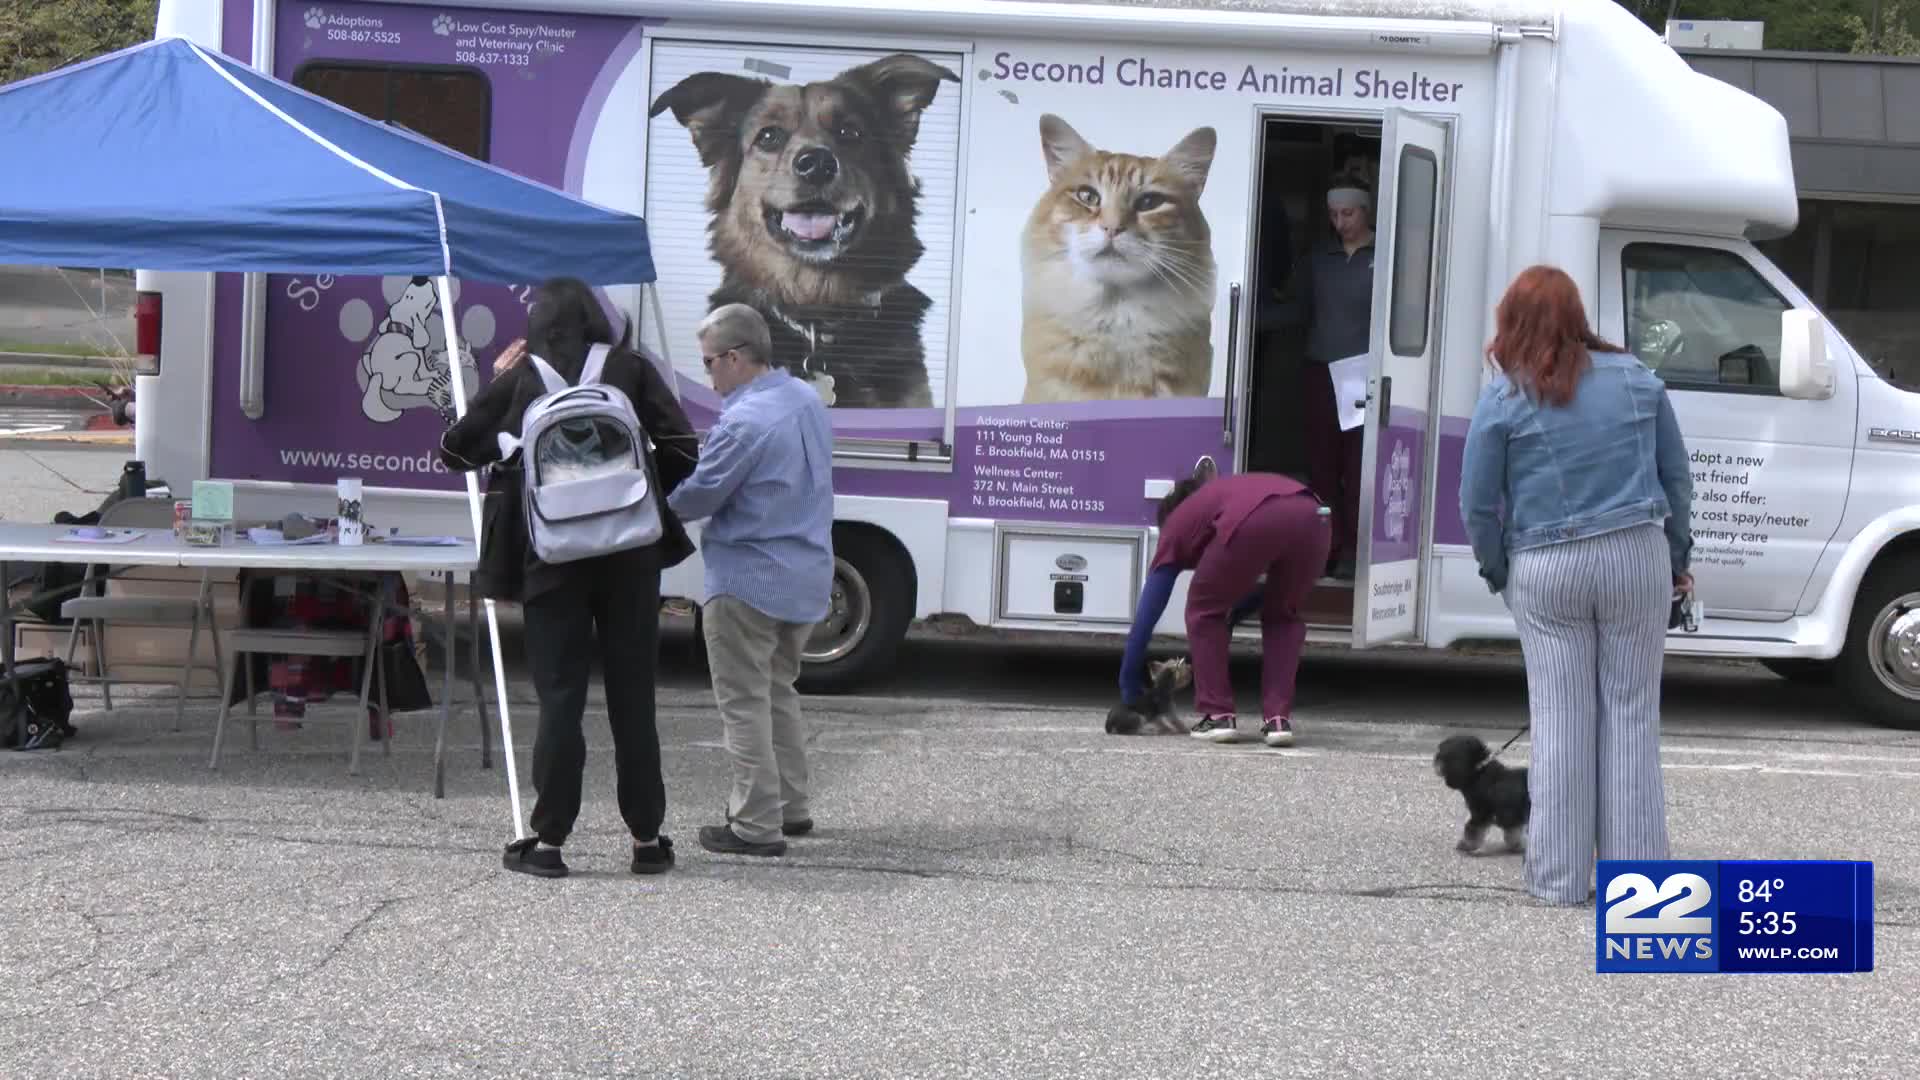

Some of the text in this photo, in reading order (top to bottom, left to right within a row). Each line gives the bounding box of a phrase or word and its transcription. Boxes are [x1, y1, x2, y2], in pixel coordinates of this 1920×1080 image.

[327, 14, 383, 28] Adoptions
[327, 29, 401, 43] 508-867-5525
[456, 23, 577, 40] Low Cost Spay/Neuter
[456, 37, 565, 53] and Veterinary Clinic
[455, 51, 529, 65] 508-637-1333
[993, 51, 1464, 103] Second Chance Animal Shelter
[976, 416, 1069, 430] Adoption Center:
[976, 431, 1063, 446] 111 Young Road
[975, 446, 1105, 461] E. Brookfield, MA 01515
[1725, 455, 1733, 465] a
[1736, 456, 1764, 467] new
[974, 465, 1063, 480] Wellness Center:
[1688, 470, 1749, 485] est friend
[973, 481, 1074, 495] 372 N. Main Street
[973, 495, 1105, 512] N. Brookfield, MA 01535
[1702, 488, 1728, 503] also
[1731, 491, 1767, 505] offer:
[1702, 509, 1729, 522] cost
[1731, 511, 1810, 528] spay/neuter
[1741, 532, 1769, 543] care
[1745, 549, 1764, 557] rates
[1705, 556, 1720, 565] that
[1721, 557, 1746, 567] qualify
